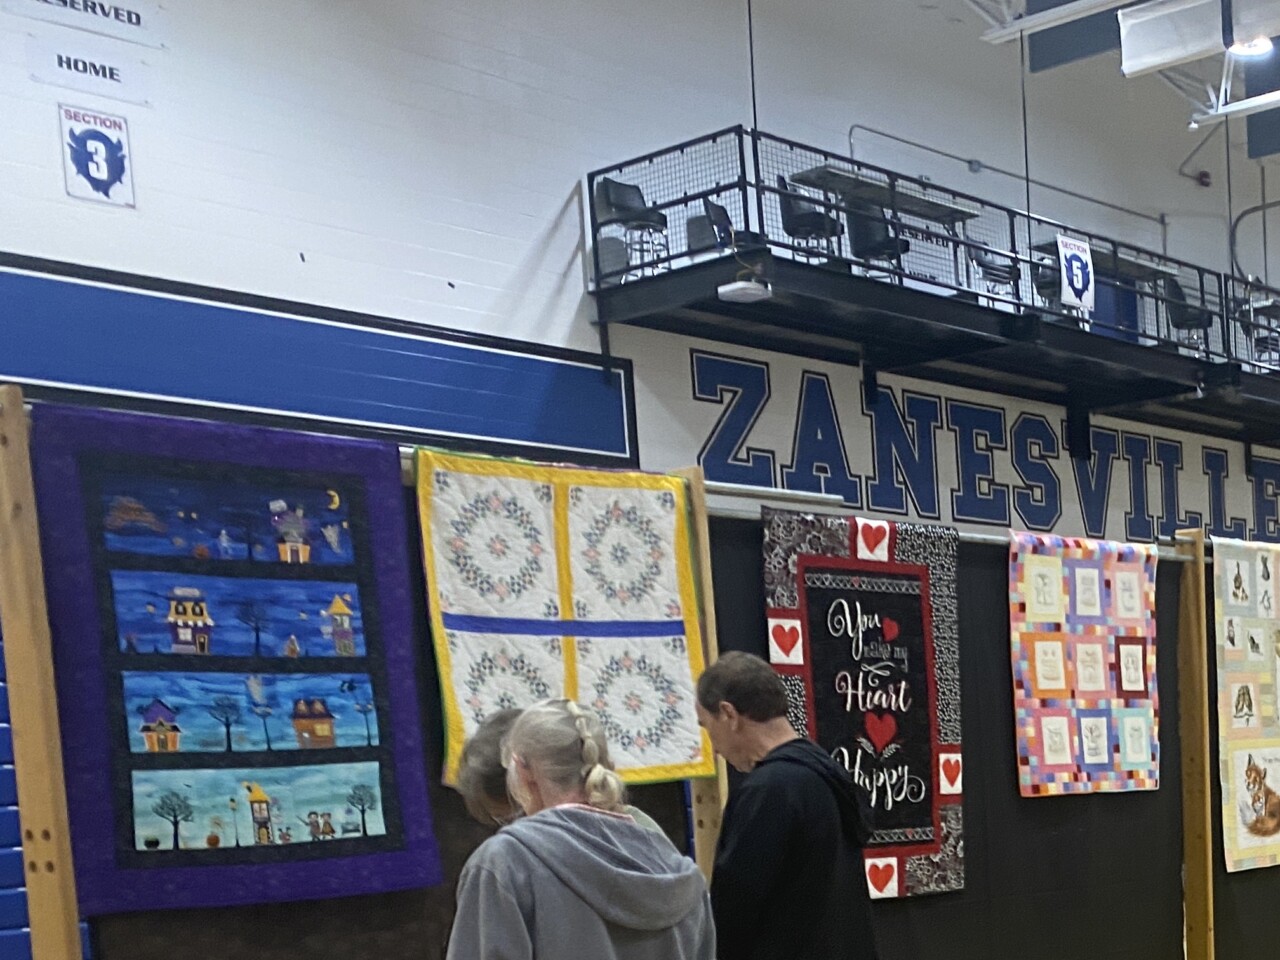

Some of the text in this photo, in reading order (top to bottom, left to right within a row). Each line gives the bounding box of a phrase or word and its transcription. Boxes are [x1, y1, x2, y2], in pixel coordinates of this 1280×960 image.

[36, 0, 141, 26] ERVED
[57, 54, 121, 83] HOME
[64, 109, 123, 131] SECTION
[86, 139, 108, 181] 3
[1060, 240, 1087, 253] SECTION
[1072, 261, 1083, 289] 5
[827, 599, 881, 660] You
[835, 671, 912, 712] Heart
